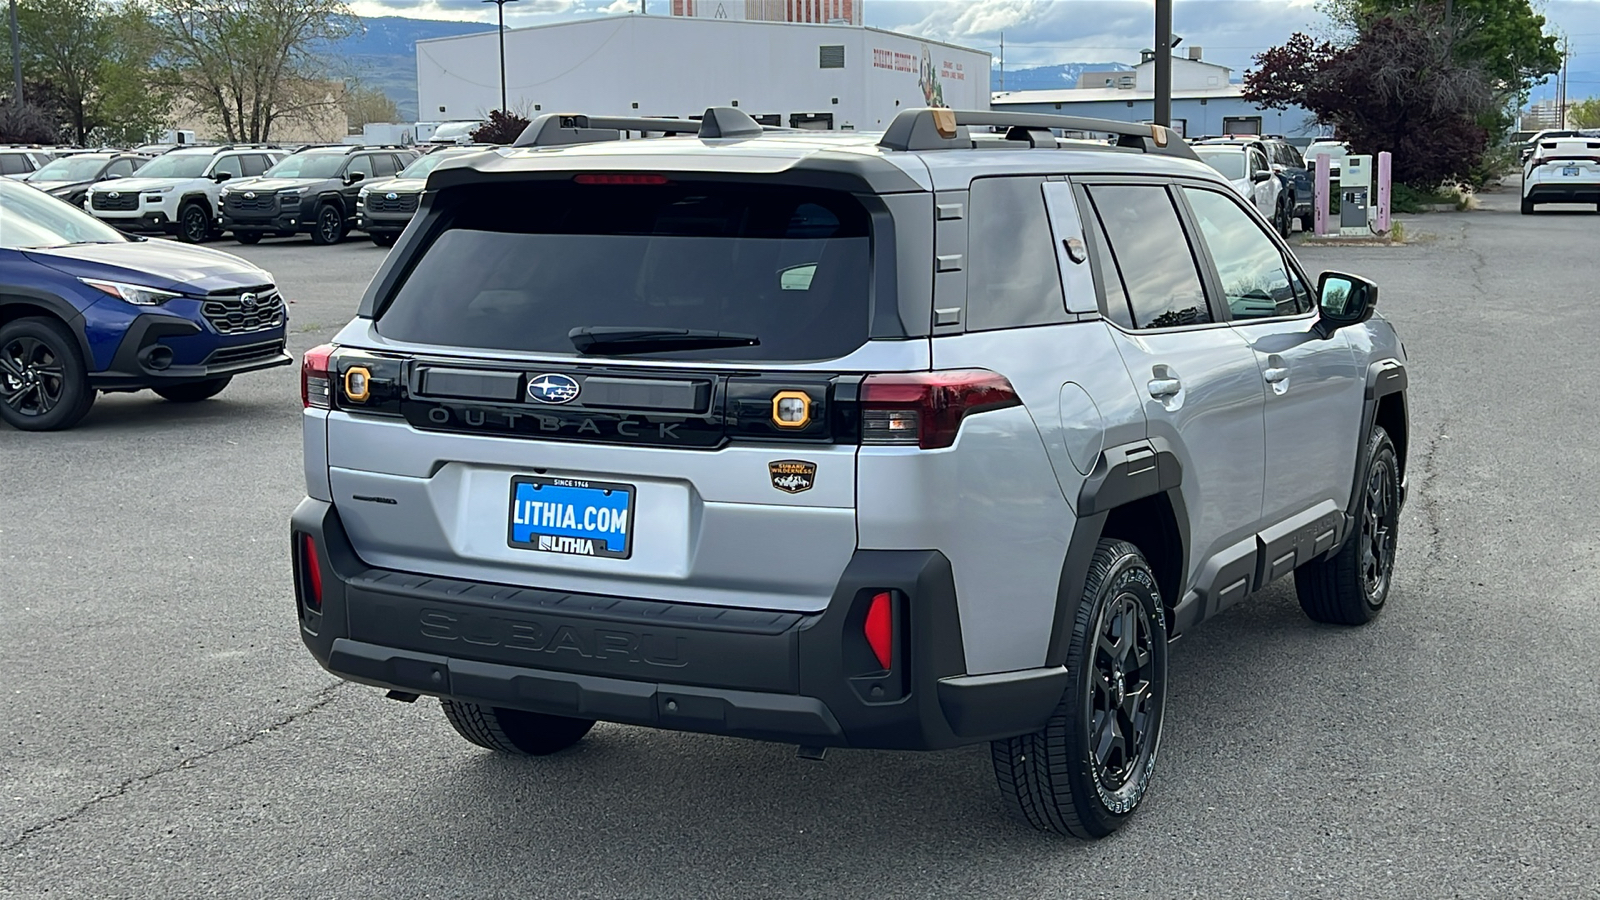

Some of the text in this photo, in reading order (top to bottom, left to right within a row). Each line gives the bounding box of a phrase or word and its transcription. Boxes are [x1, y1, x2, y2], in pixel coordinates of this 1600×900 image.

[428, 407, 680, 439] OUTBACK
[554, 479, 573, 487] SINCE
[513, 499, 628, 534] LITHIA.COM
[551, 536, 595, 555] LITHIA
[420, 607, 689, 668] SUBARU
